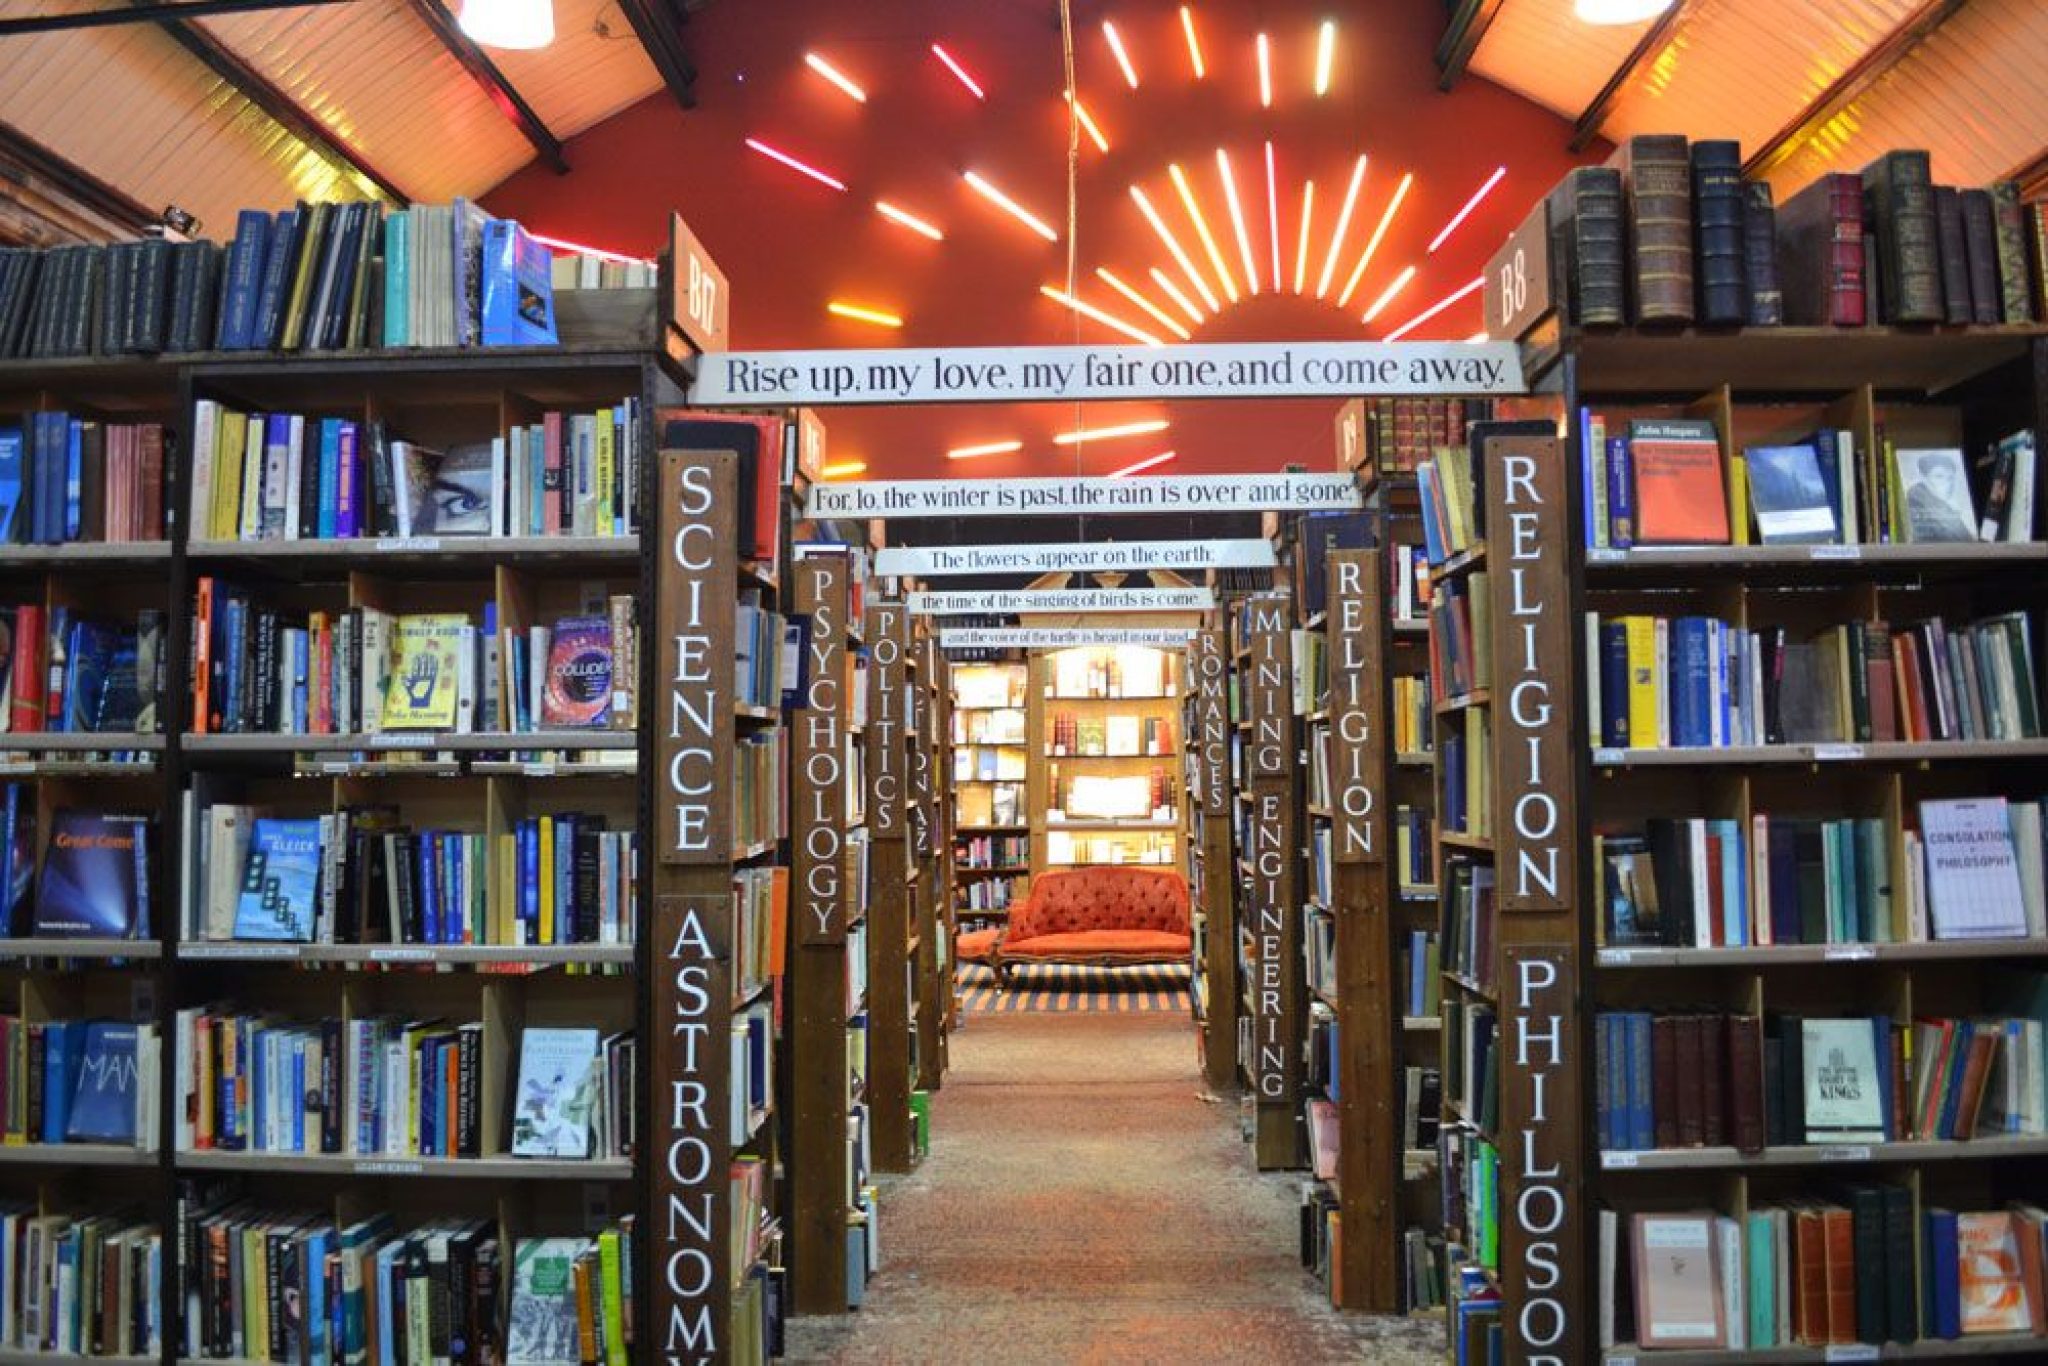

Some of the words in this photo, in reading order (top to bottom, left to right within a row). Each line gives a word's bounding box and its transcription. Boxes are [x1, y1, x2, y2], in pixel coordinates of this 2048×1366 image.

[727, 359, 798, 392] Rise
[869, 363, 919, 394] my
[1023, 362, 1074, 394] my
[1085, 354, 1143, 389] fair
[1227, 351, 1291, 386] and
[1302, 357, 1398, 384] come
[1408, 356, 1504, 389] away.
[1501, 248, 1526, 327] B8
[884, 486, 916, 508] the
[923, 485, 989, 508] winter
[998, 484, 1015, 507] is
[1072, 482, 1104, 505] the
[1109, 482, 1153, 504] rain
[1161, 481, 1180, 503] is
[1187, 485, 1241, 503] over
[1249, 479, 1290, 502] and
[922, 594, 942, 609] the
[945, 594, 976, 609] time
[980, 593, 995, 608] of
[999, 593, 1022, 608] the
[1025, 592, 1079, 610] singing
[1080, 592, 1096, 607] of
[1100, 591, 1138, 606] birds
[1141, 592, 1153, 606] is
[932, 551, 964, 569] The
[968, 549, 1030, 568] flowers
[1036, 549, 1098, 569] appear
[1104, 550, 1125, 564] on
[1132, 547, 1158, 564] the
[670, 466, 716, 851] SCIENCE
[806, 570, 839, 934] PSYCHOLOGY
[874, 611, 898, 829] POLITICS
[1201, 634, 1225, 808] ROMANCES
[1256, 607, 1282, 771] MINING
[1338, 562, 1373, 853] RELIGION
[1503, 456, 1559, 898] RELIGION
[1259, 796, 1283, 1097] ENGINEERING
[665, 908, 717, 1366] ASTRONOM
[1516, 960, 1568, 1366] PHILOSO
